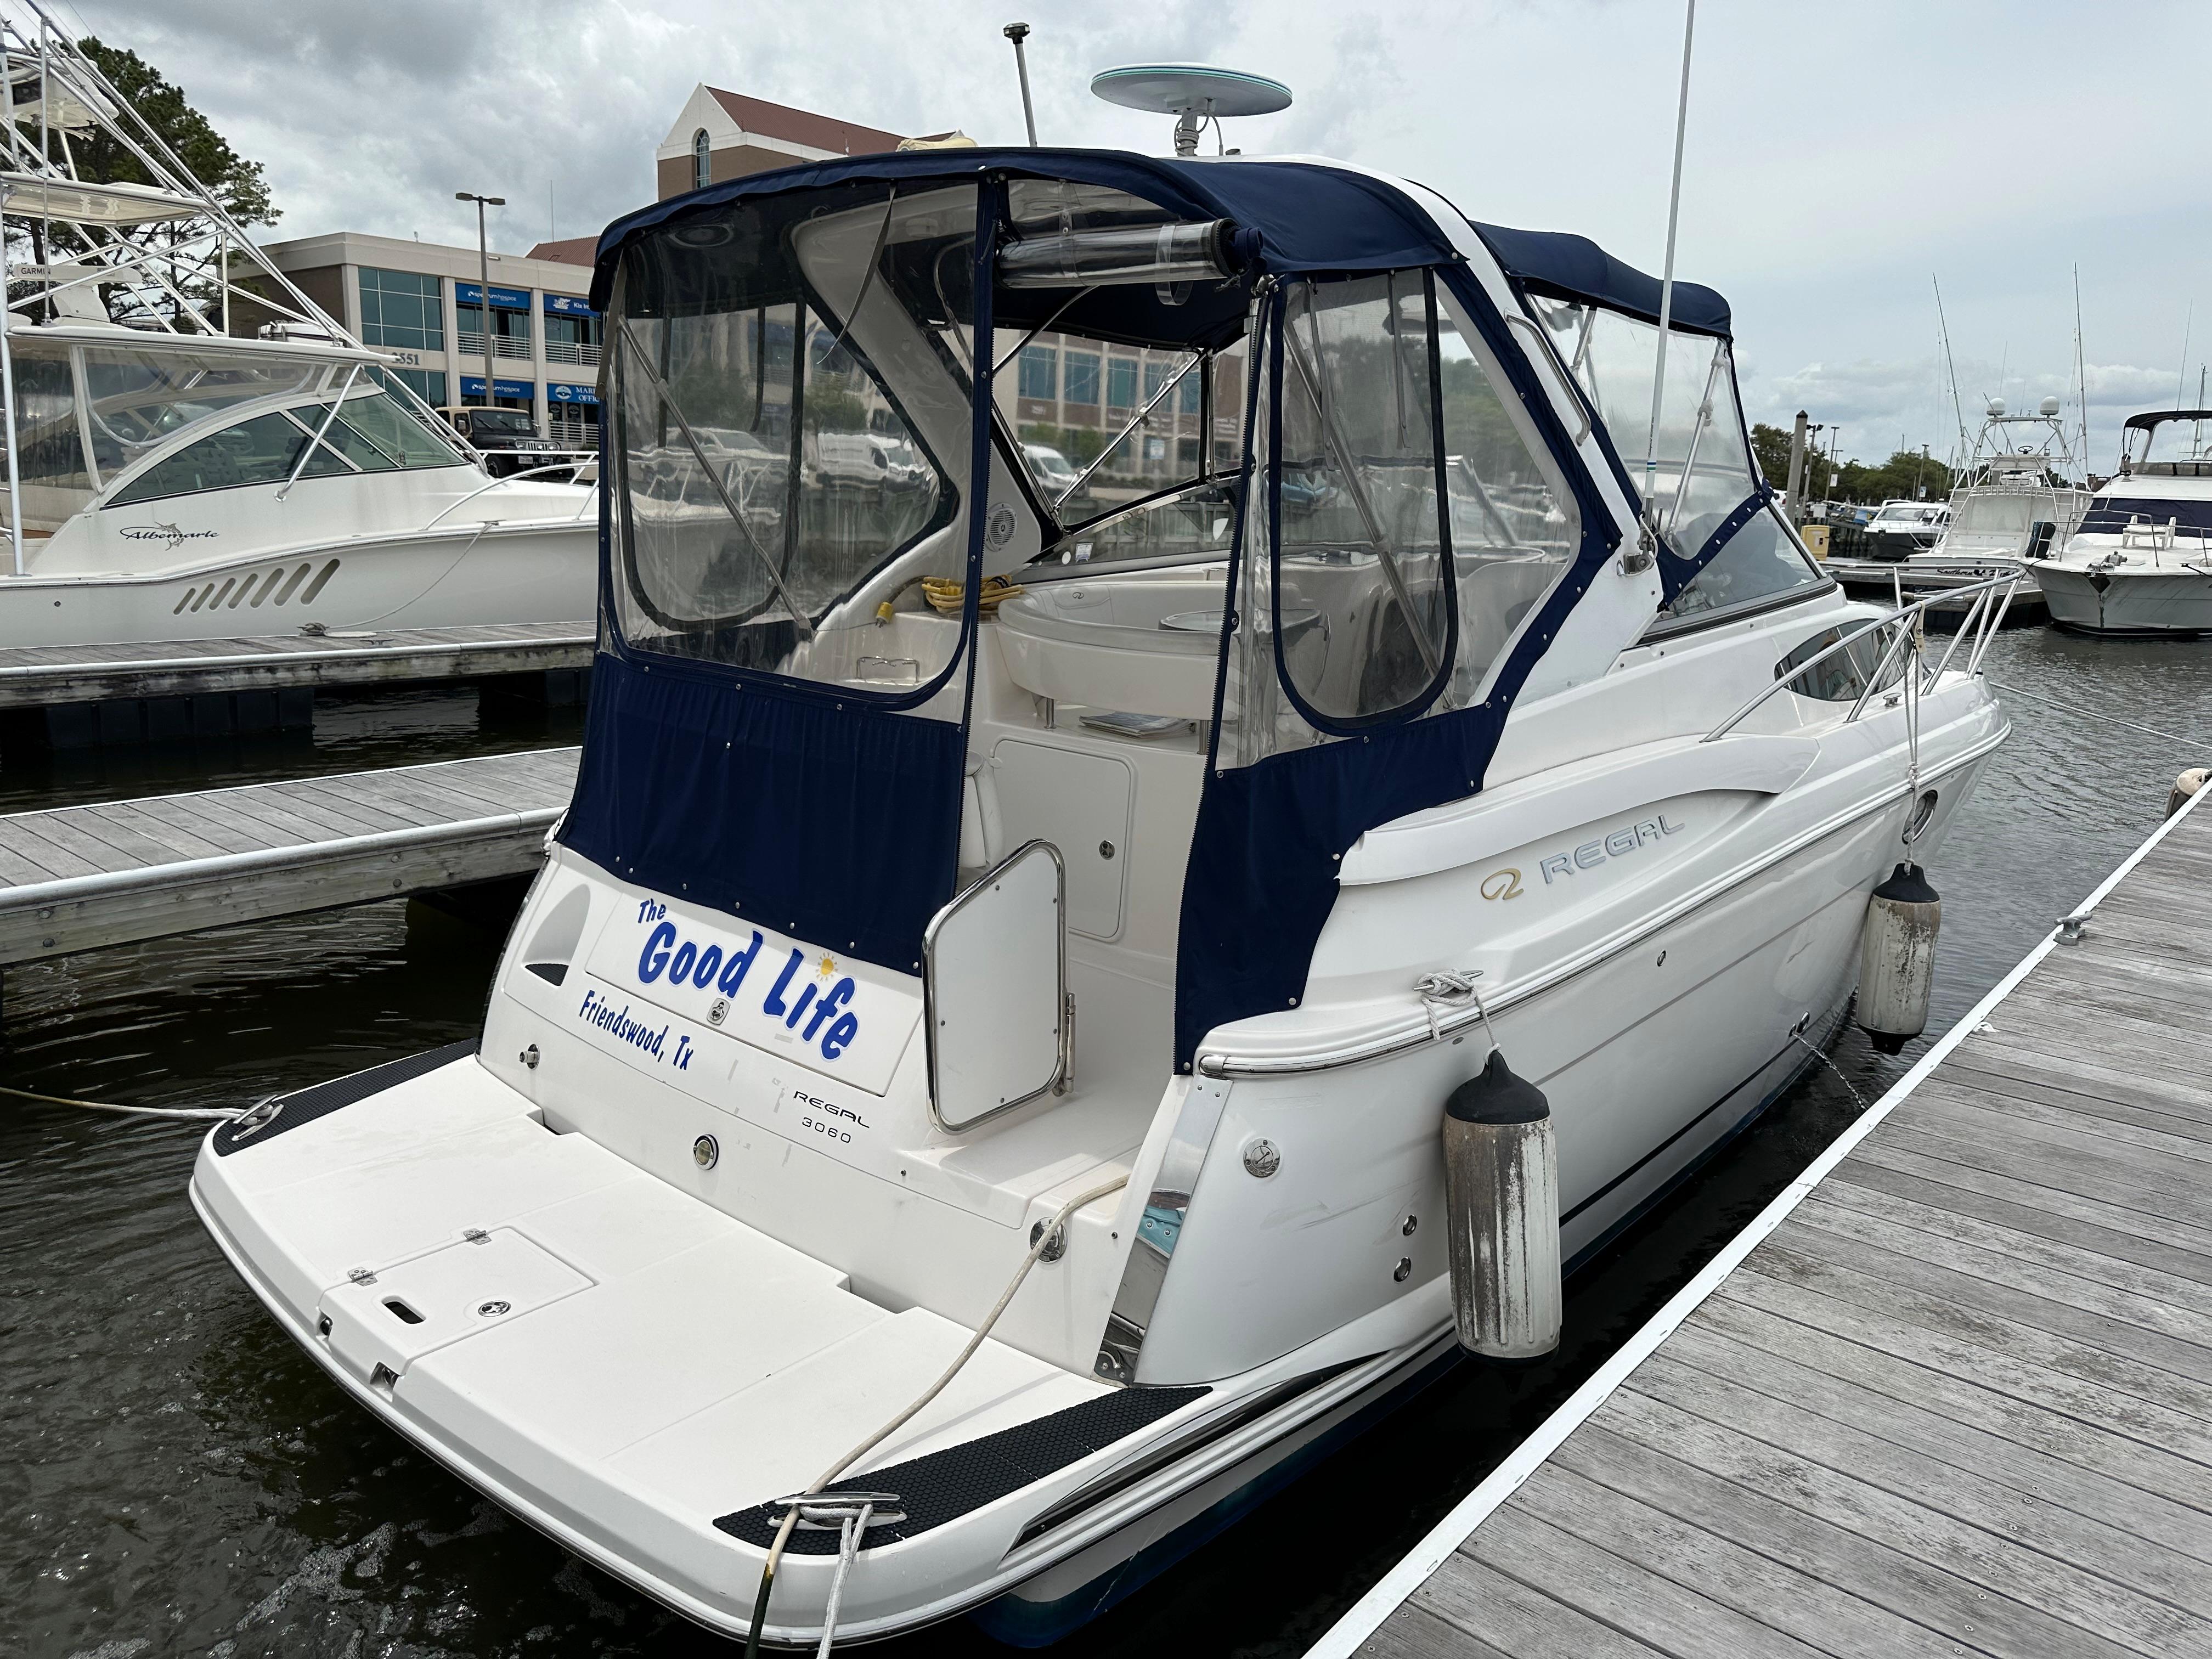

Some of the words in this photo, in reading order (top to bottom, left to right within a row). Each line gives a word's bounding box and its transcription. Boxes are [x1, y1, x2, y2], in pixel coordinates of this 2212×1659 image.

[578, 394, 600, 403] OFFIC
[120, 526, 220, 540] Albemarle
[1540, 815, 1685, 884] REGAL
[637, 898, 667, 923] The
[637, 921, 764, 999] Good
[763, 947, 859, 1061] Life
[579, 989, 669, 1063] Friendswood,
[673, 1035, 693, 1070] Tx
[793, 1091, 871, 1129] REGAL
[802, 1117, 852, 1144] 3060
